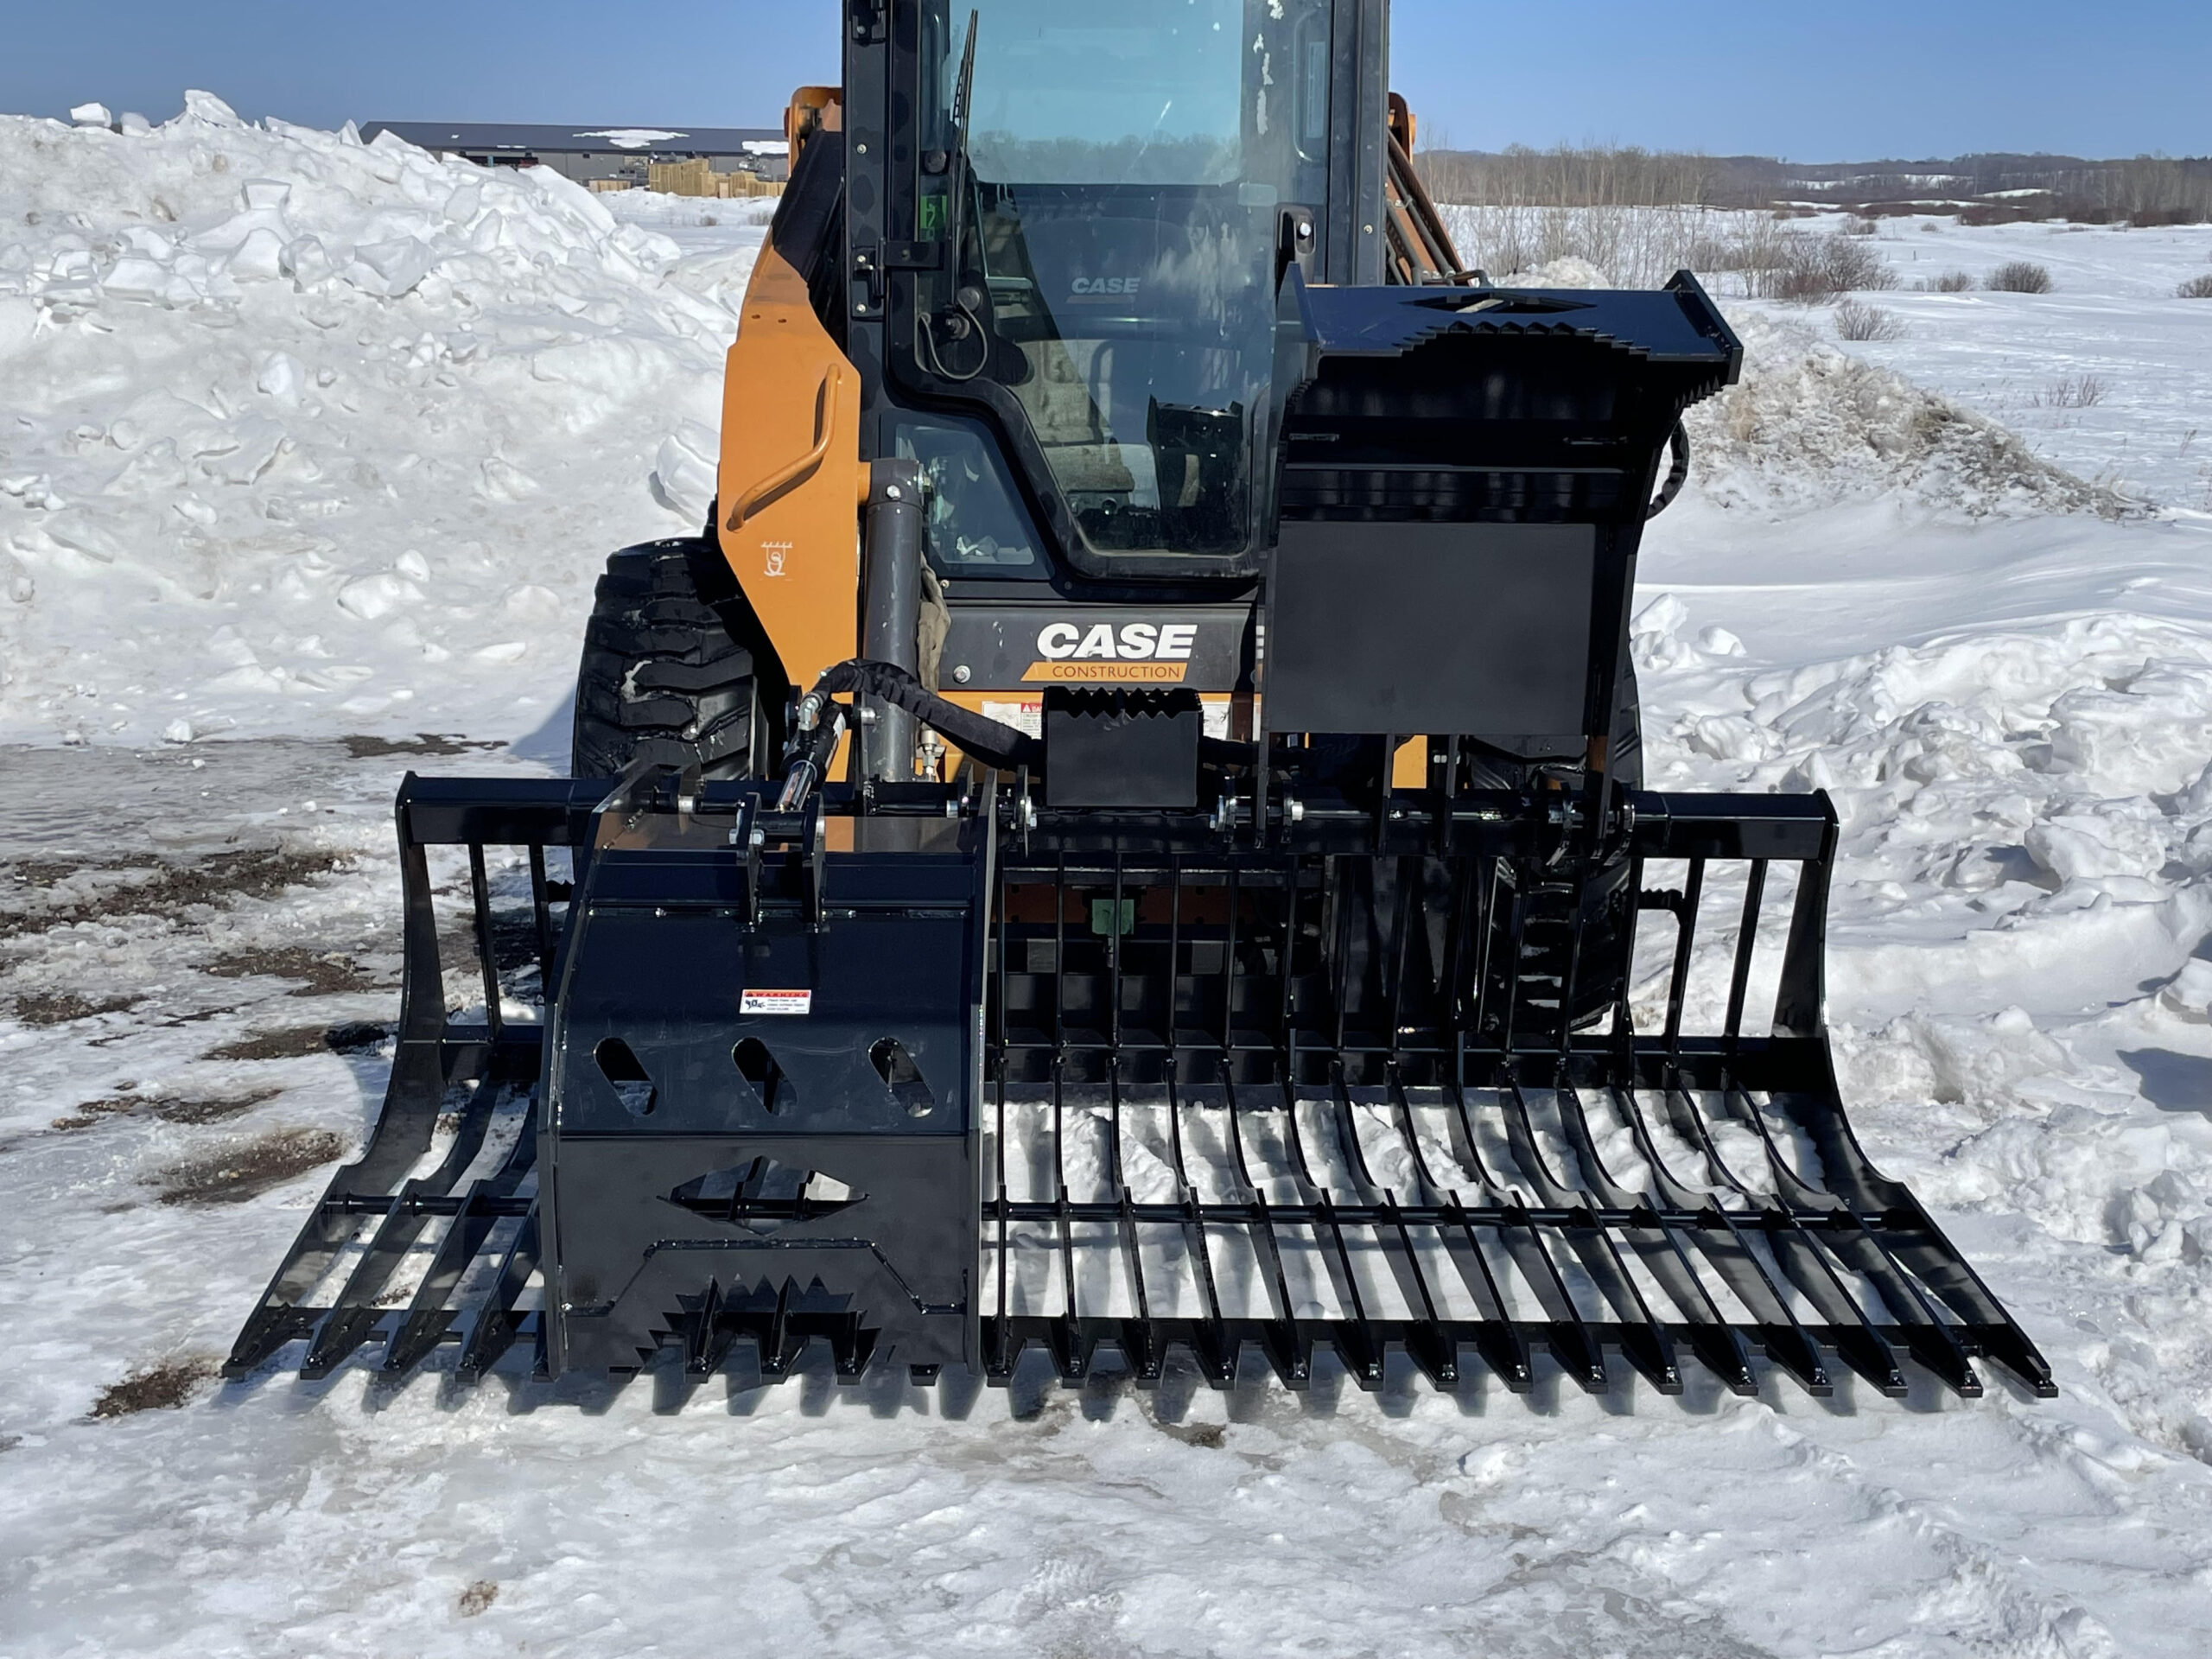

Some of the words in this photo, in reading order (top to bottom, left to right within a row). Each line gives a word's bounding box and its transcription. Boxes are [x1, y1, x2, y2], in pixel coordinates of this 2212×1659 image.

[1071, 277, 1141, 294] CASE
[1037, 622, 1198, 659] CASE
[1052, 665, 1180, 678] CONSTRUCTION
